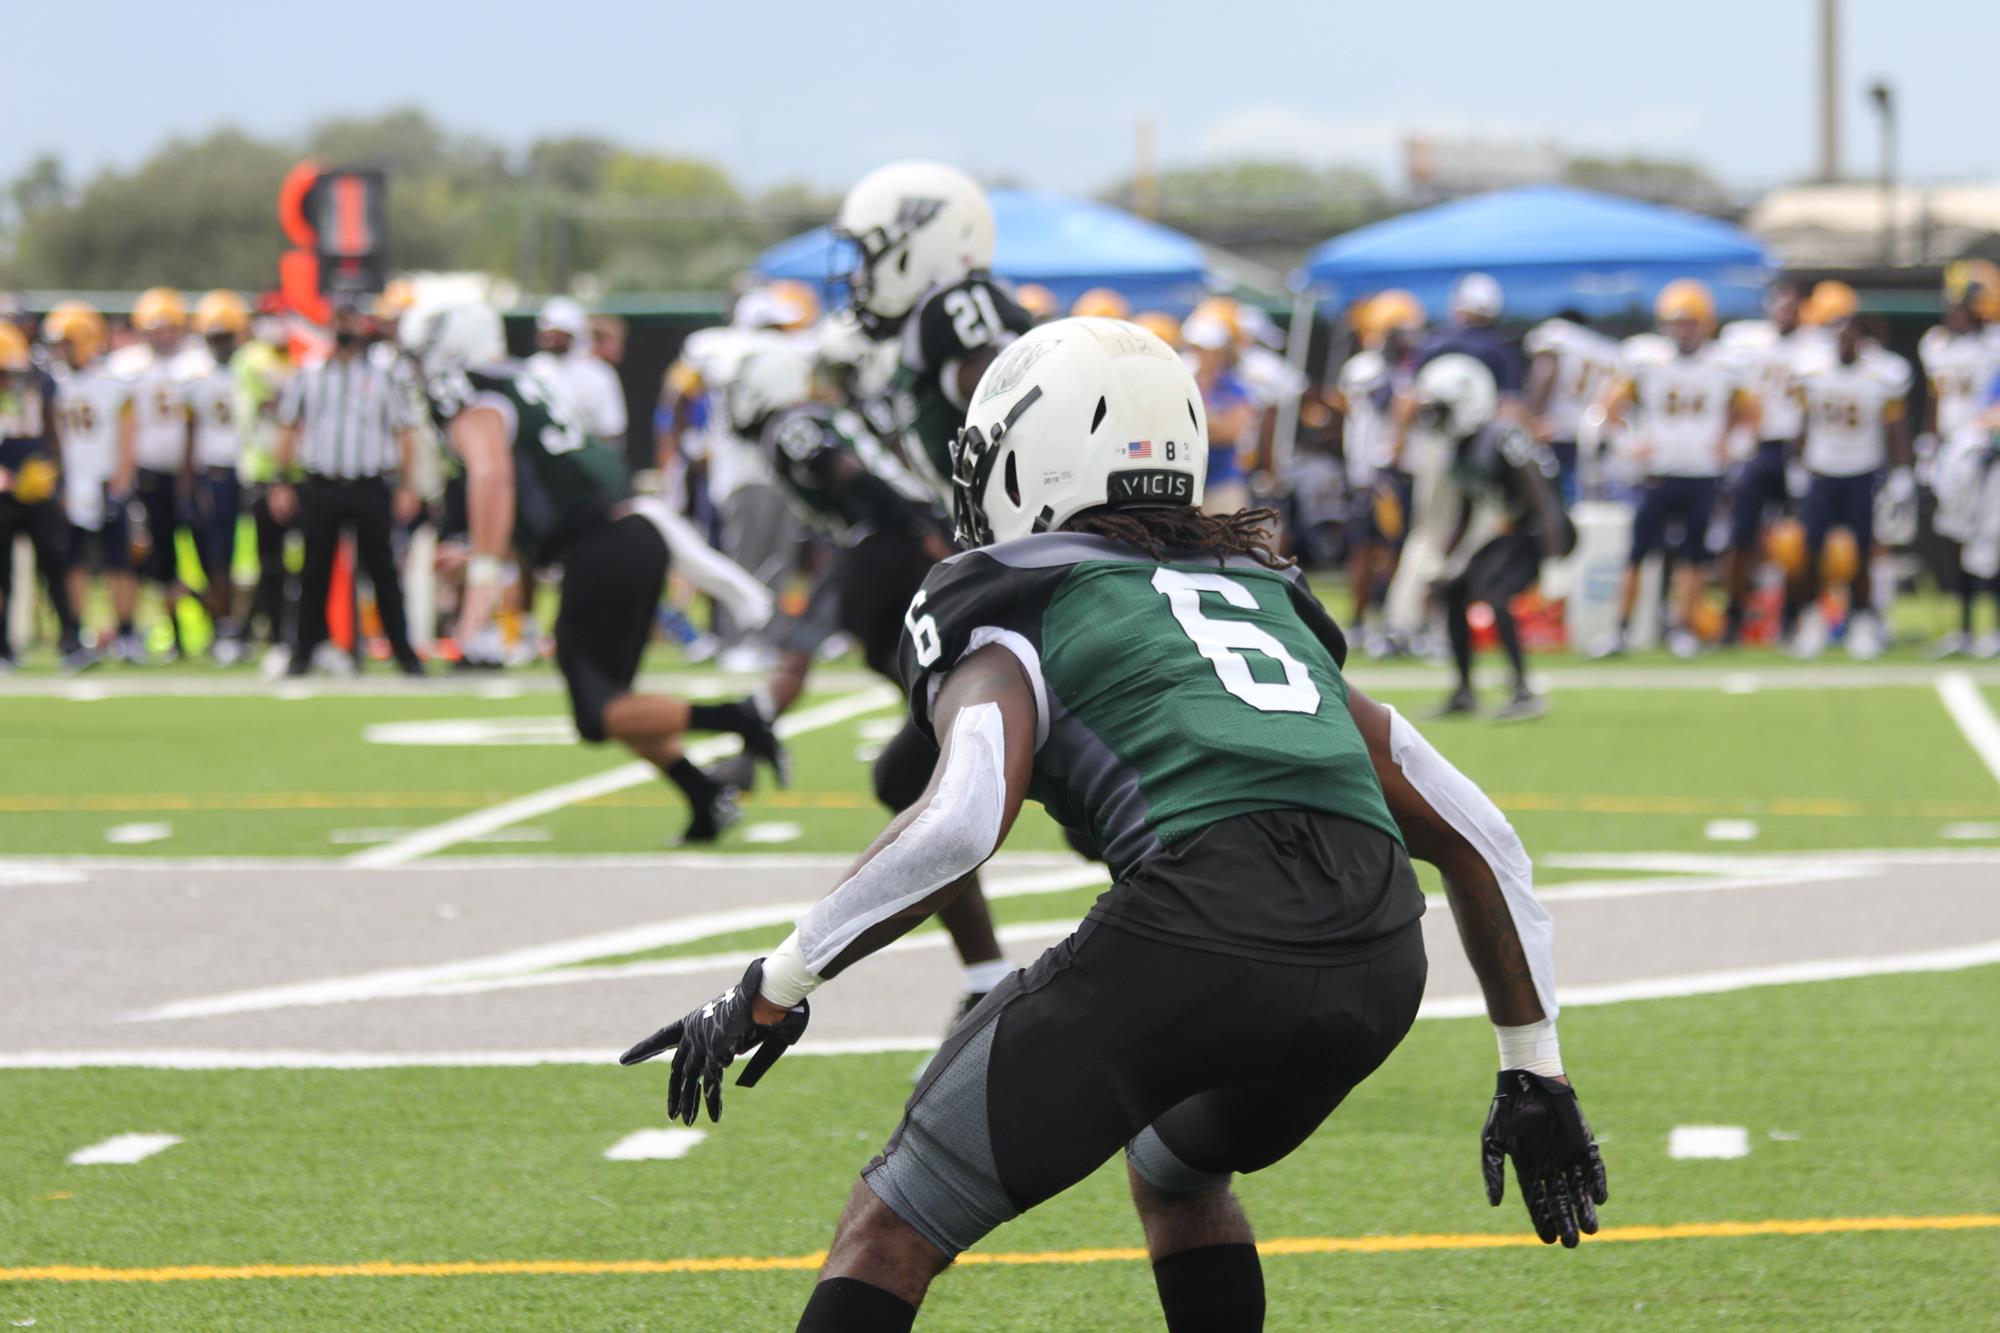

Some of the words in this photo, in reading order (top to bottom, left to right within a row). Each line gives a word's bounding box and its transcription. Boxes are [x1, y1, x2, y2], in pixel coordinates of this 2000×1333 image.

[944, 285, 1003, 348] 21
[1165, 441, 1176, 461] 8
[1121, 475, 1187, 496] VICIS
[905, 590, 942, 668] 6
[1150, 566, 1321, 714] 6
